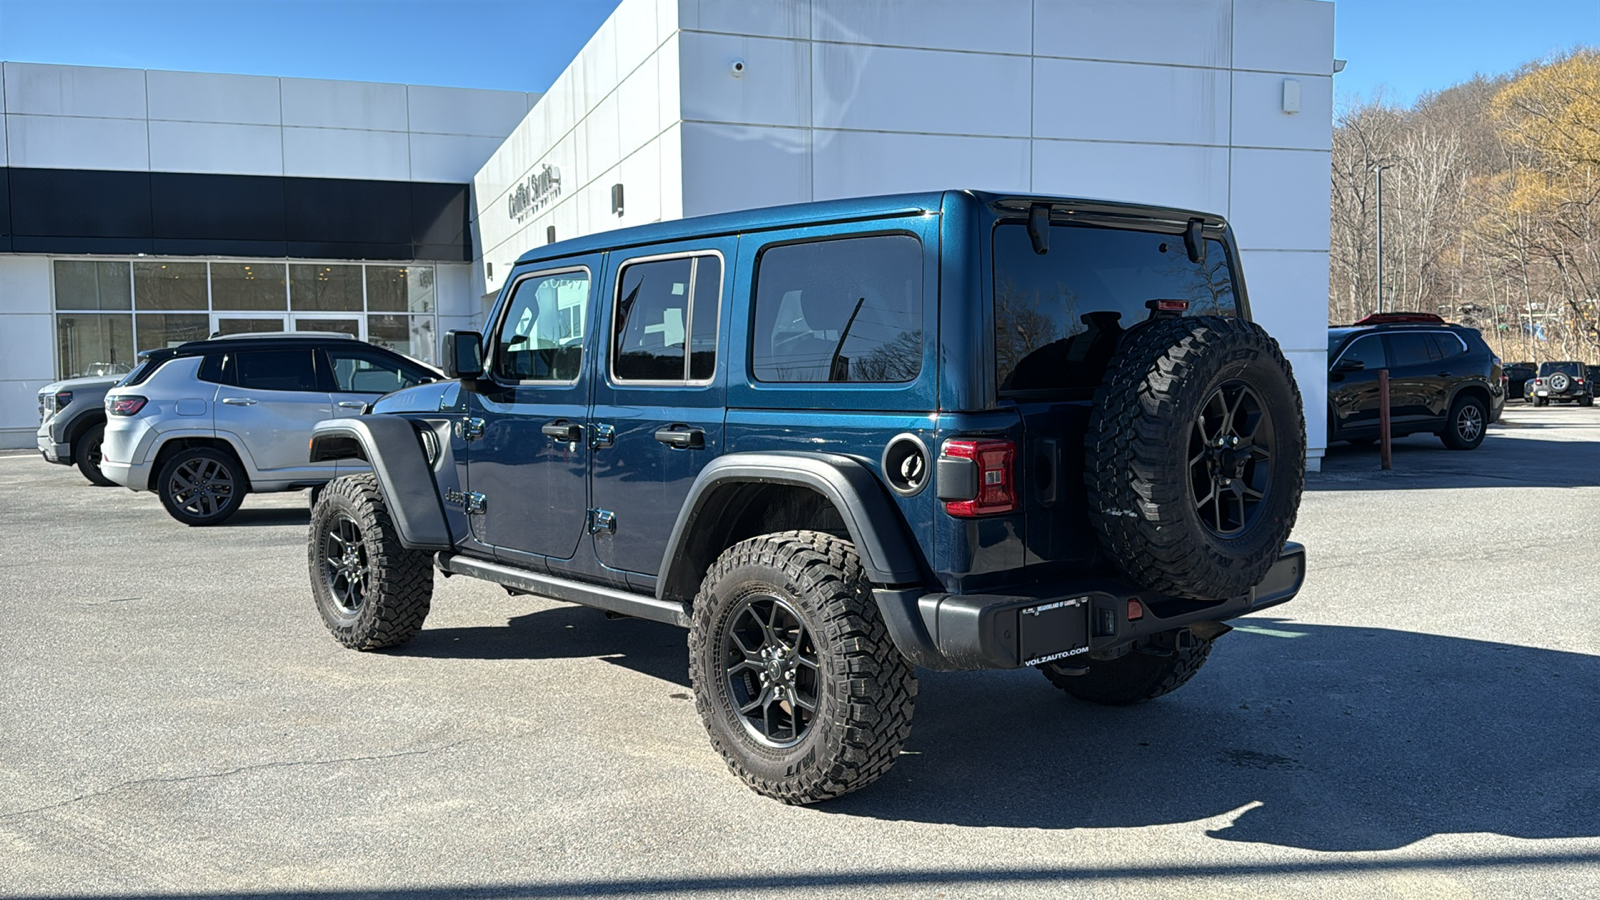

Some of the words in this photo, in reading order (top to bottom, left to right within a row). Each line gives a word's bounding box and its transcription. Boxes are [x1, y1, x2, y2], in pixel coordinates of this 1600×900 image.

[444, 486, 465, 507] Jeep
[784, 582, 837, 745] WILDPEAK
[1025, 646, 1089, 666] VOLZAUTO.COM
